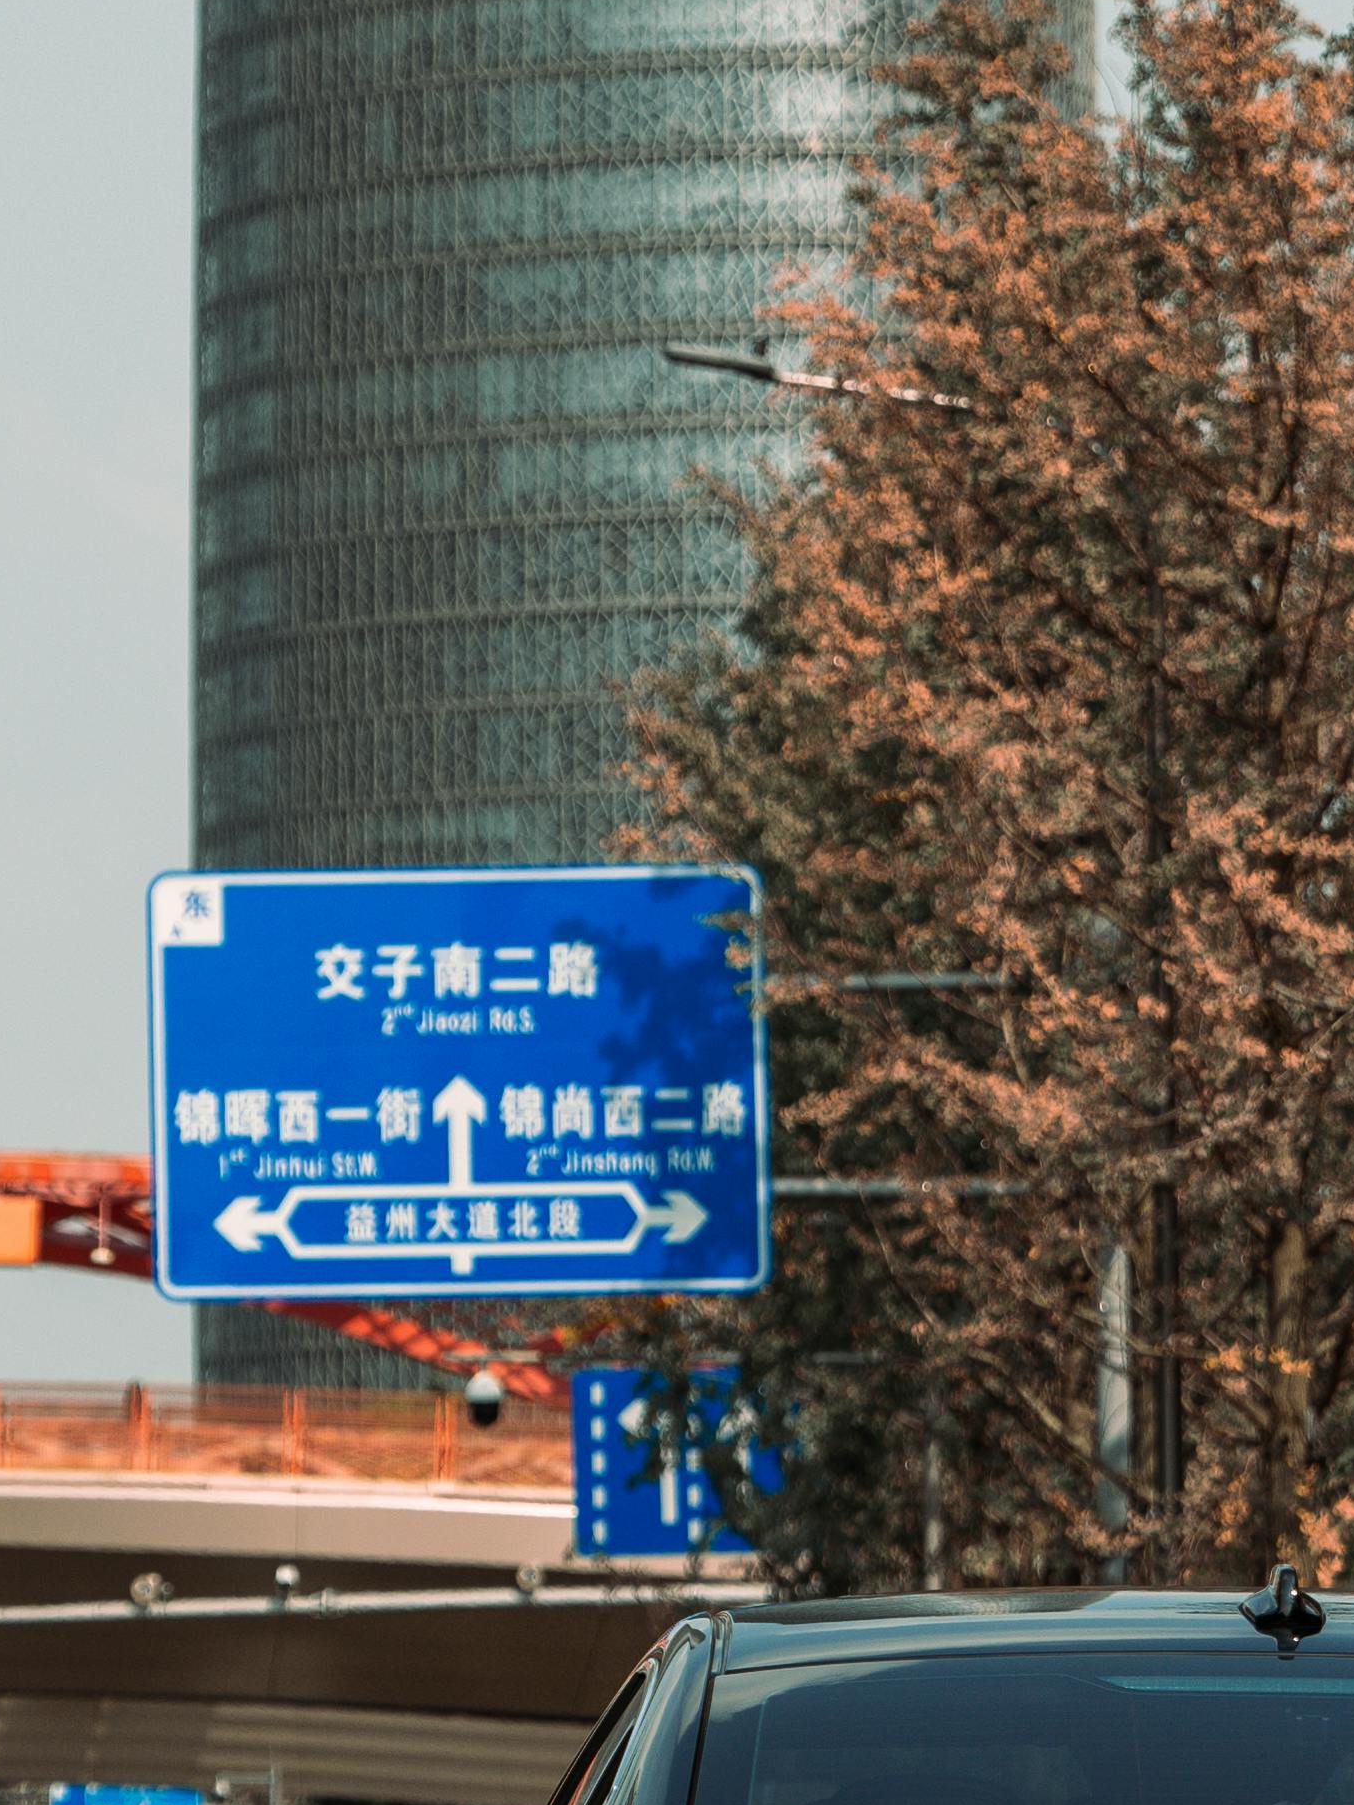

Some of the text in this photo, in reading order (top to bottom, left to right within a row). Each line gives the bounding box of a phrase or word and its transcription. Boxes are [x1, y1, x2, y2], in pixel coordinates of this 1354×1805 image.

[314, 942, 599, 999] 交子南二路
[416, 1008, 478, 1034] Jiaozi
[174, 1087, 423, 1145] 锦晖西一街
[499, 1082, 747, 1141] 锦尚西二路
[253, 1152, 324, 1179] Jinhui
[561, 1149, 660, 1181] Jinshang
[346, 1199, 582, 1243] 益州大道北段
